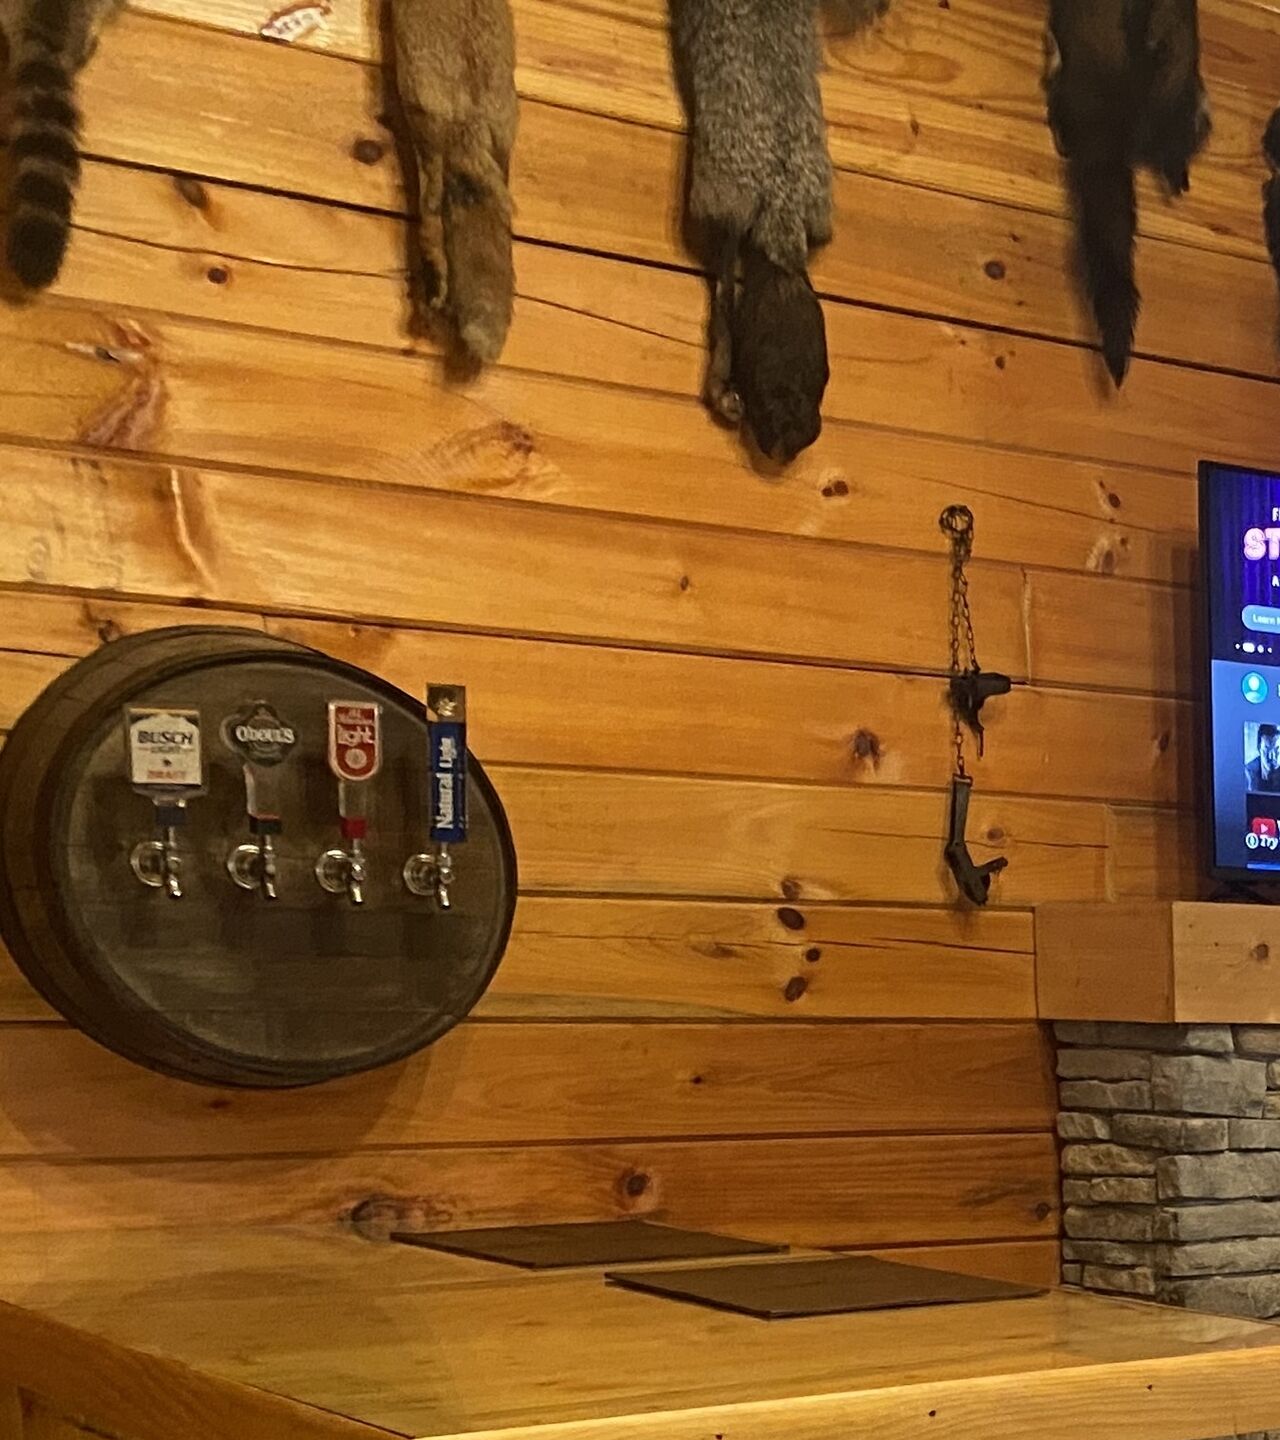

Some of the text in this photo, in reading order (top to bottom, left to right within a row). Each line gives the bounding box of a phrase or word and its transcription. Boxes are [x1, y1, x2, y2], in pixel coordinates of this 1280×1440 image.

[1271, 575, 1280, 587] A
[138, 730, 193, 745] BUSCH
[435, 771, 454, 830] Natural
[1259, 834, 1279, 850] Try
